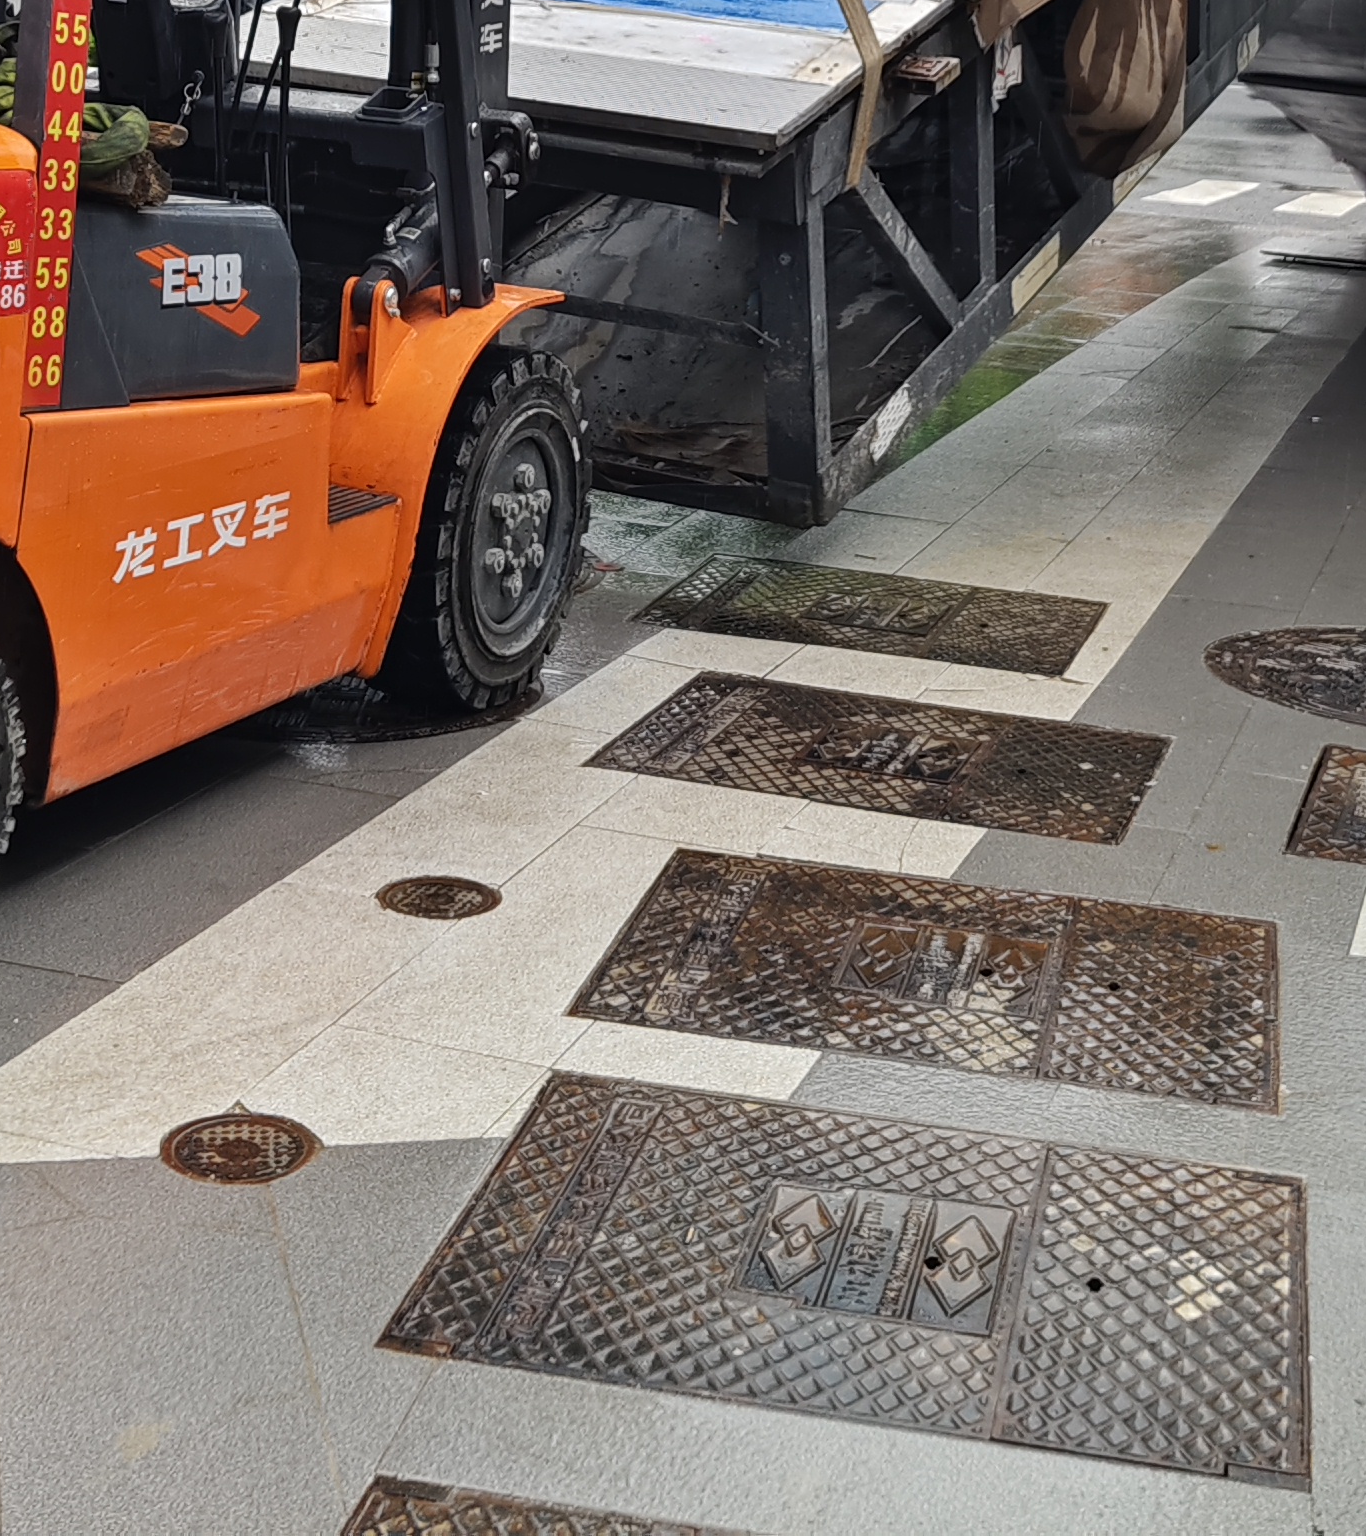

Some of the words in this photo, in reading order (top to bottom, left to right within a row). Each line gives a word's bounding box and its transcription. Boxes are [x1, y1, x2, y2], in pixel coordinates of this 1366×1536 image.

[161, 253, 243, 307] E38
[111, 490, 291, 584] 龙工叉车
